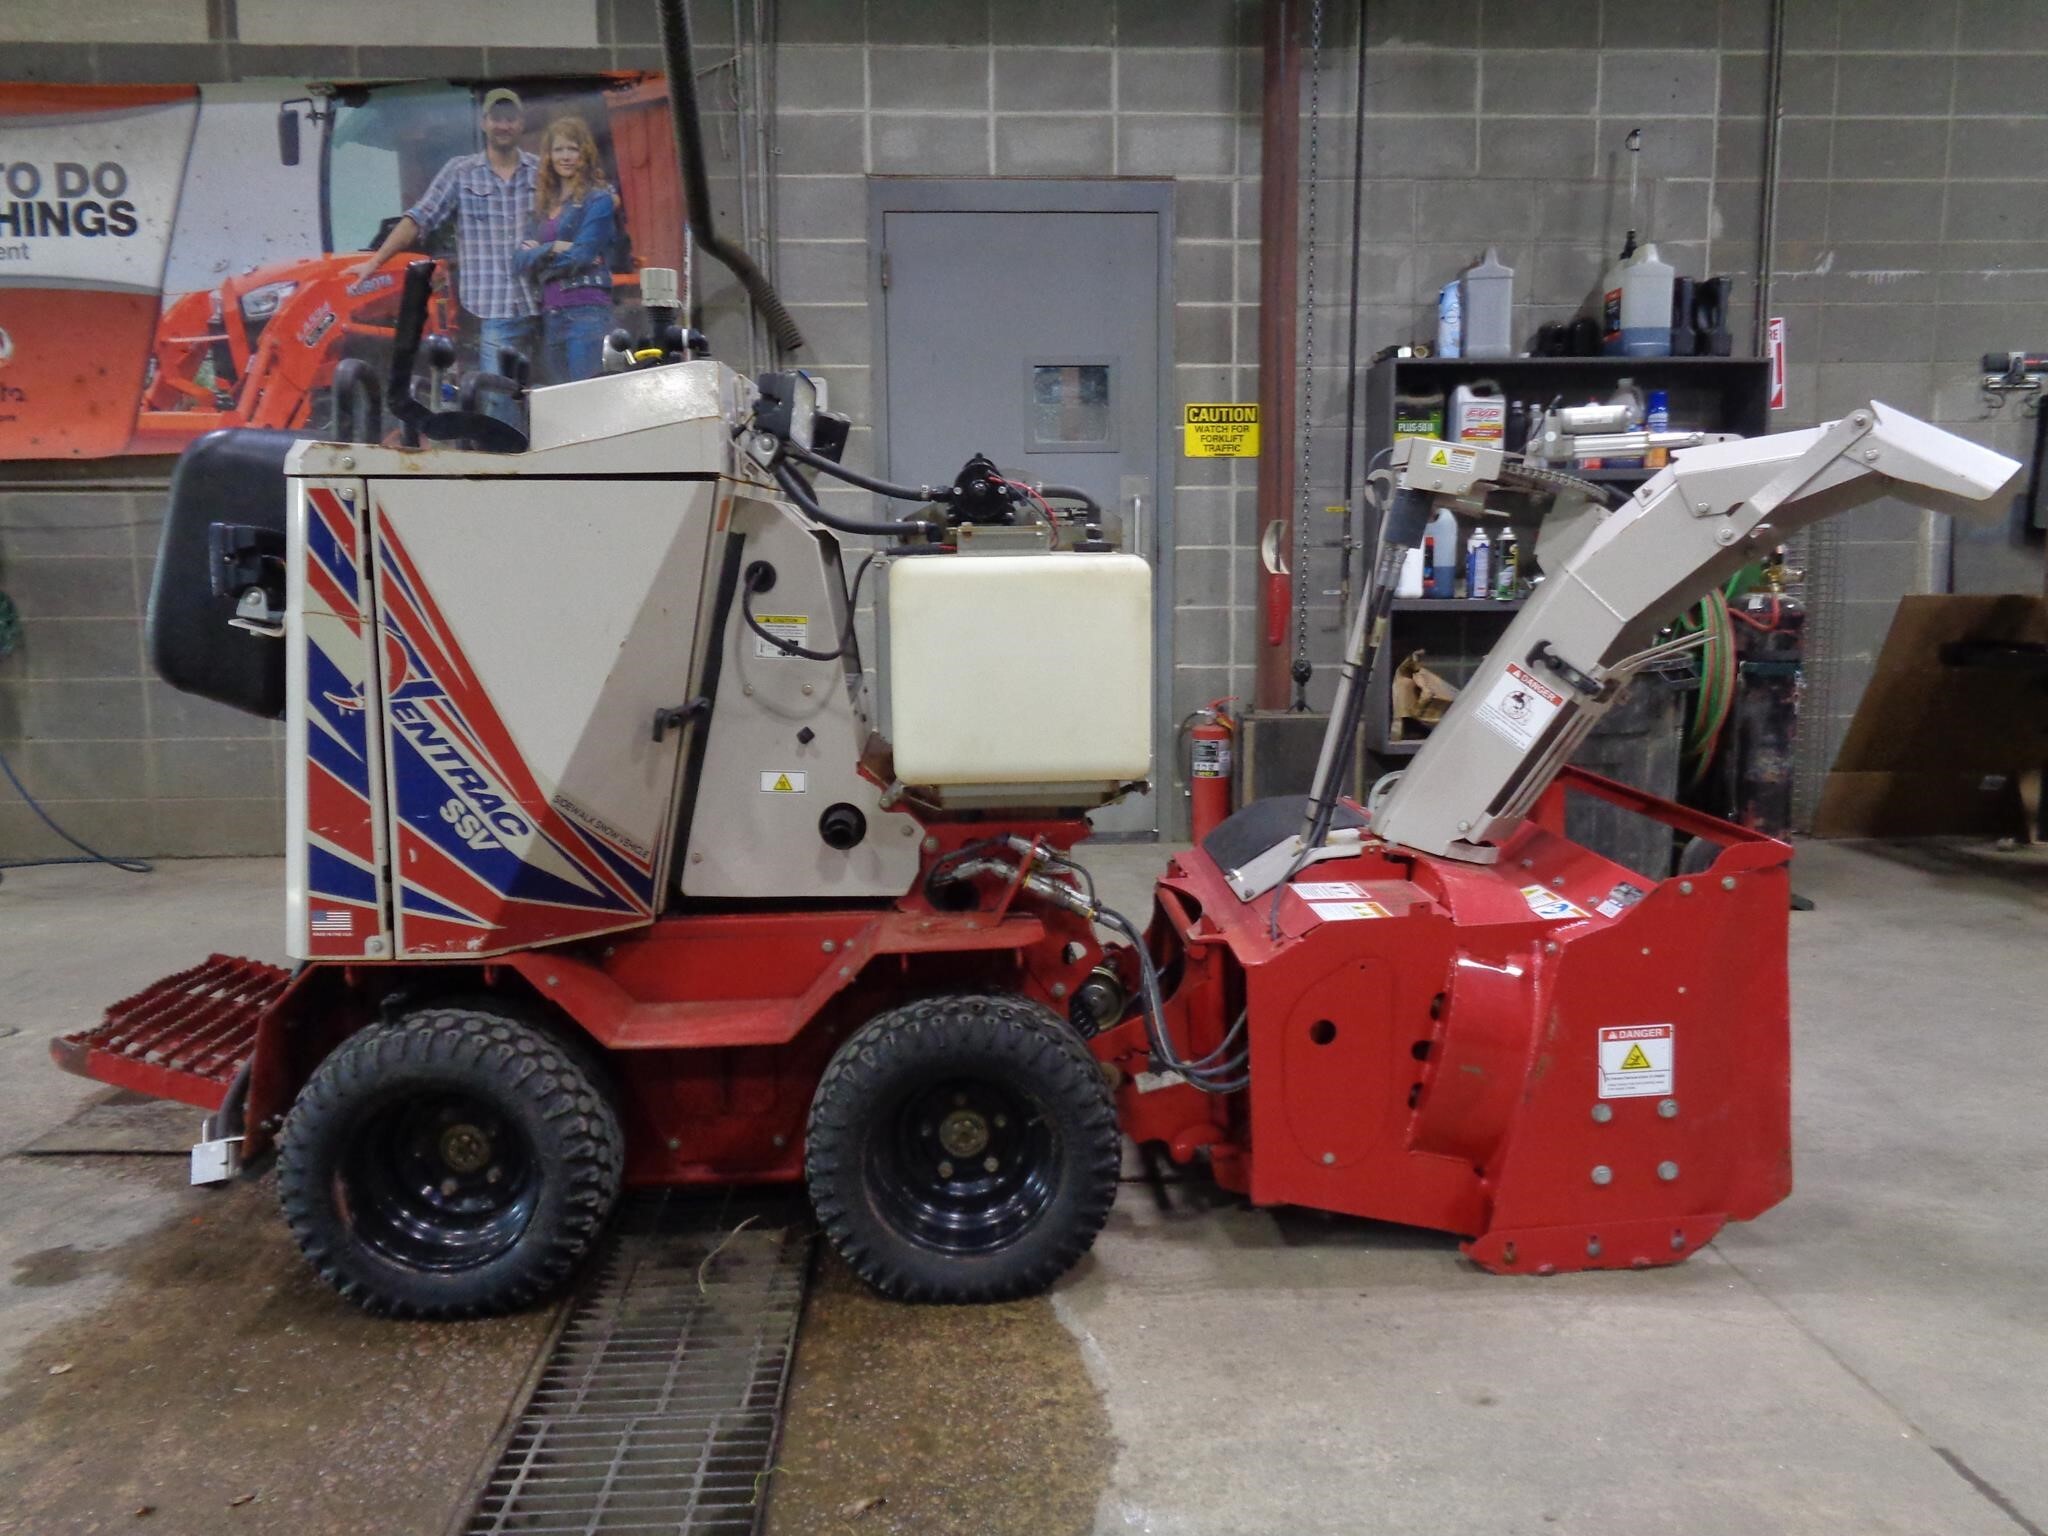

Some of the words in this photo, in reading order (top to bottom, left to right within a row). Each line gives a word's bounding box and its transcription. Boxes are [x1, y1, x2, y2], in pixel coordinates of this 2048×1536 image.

[0, 162, 41, 199] O
[54, 162, 127, 199] DO
[1189, 407, 1256, 422] CAUTION
[1200, 434, 1243, 442] FORKLIFT
[1203, 444, 1241, 452] TRAFFIC
[1520, 671, 1557, 703] DANGER
[439, 798, 502, 850] SSV
[553, 794, 596, 825] SIDEWALK
[594, 820, 620, 839] SNOW
[619, 836, 650, 859] VEHICLE
[1619, 1028, 1663, 1039] DANGER
